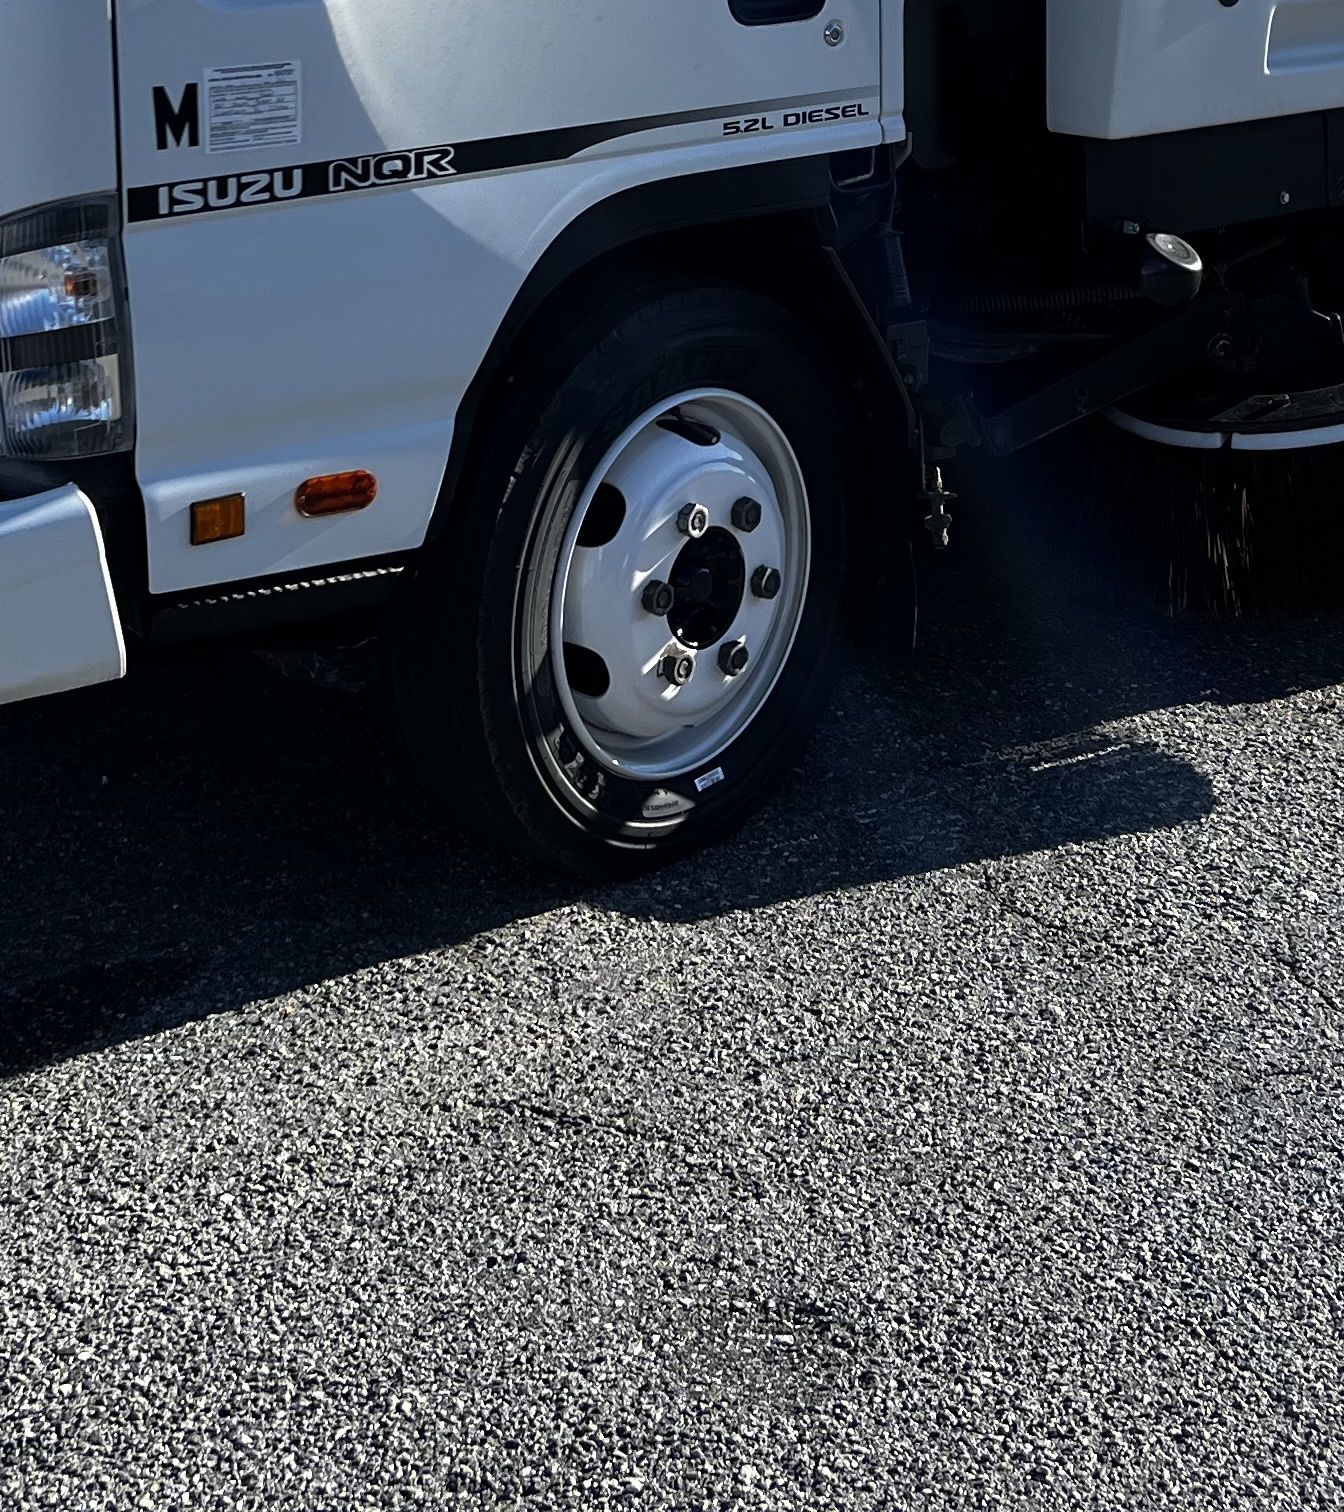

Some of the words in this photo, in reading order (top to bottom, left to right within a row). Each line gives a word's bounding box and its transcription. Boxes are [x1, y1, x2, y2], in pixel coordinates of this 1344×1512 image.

[152, 82, 200, 150] M
[722, 117, 774, 136] 5.2L
[783, 103, 869, 127] DIESEL
[158, 168, 303, 215] ISUZU
[328, 146, 458, 192] NQR
